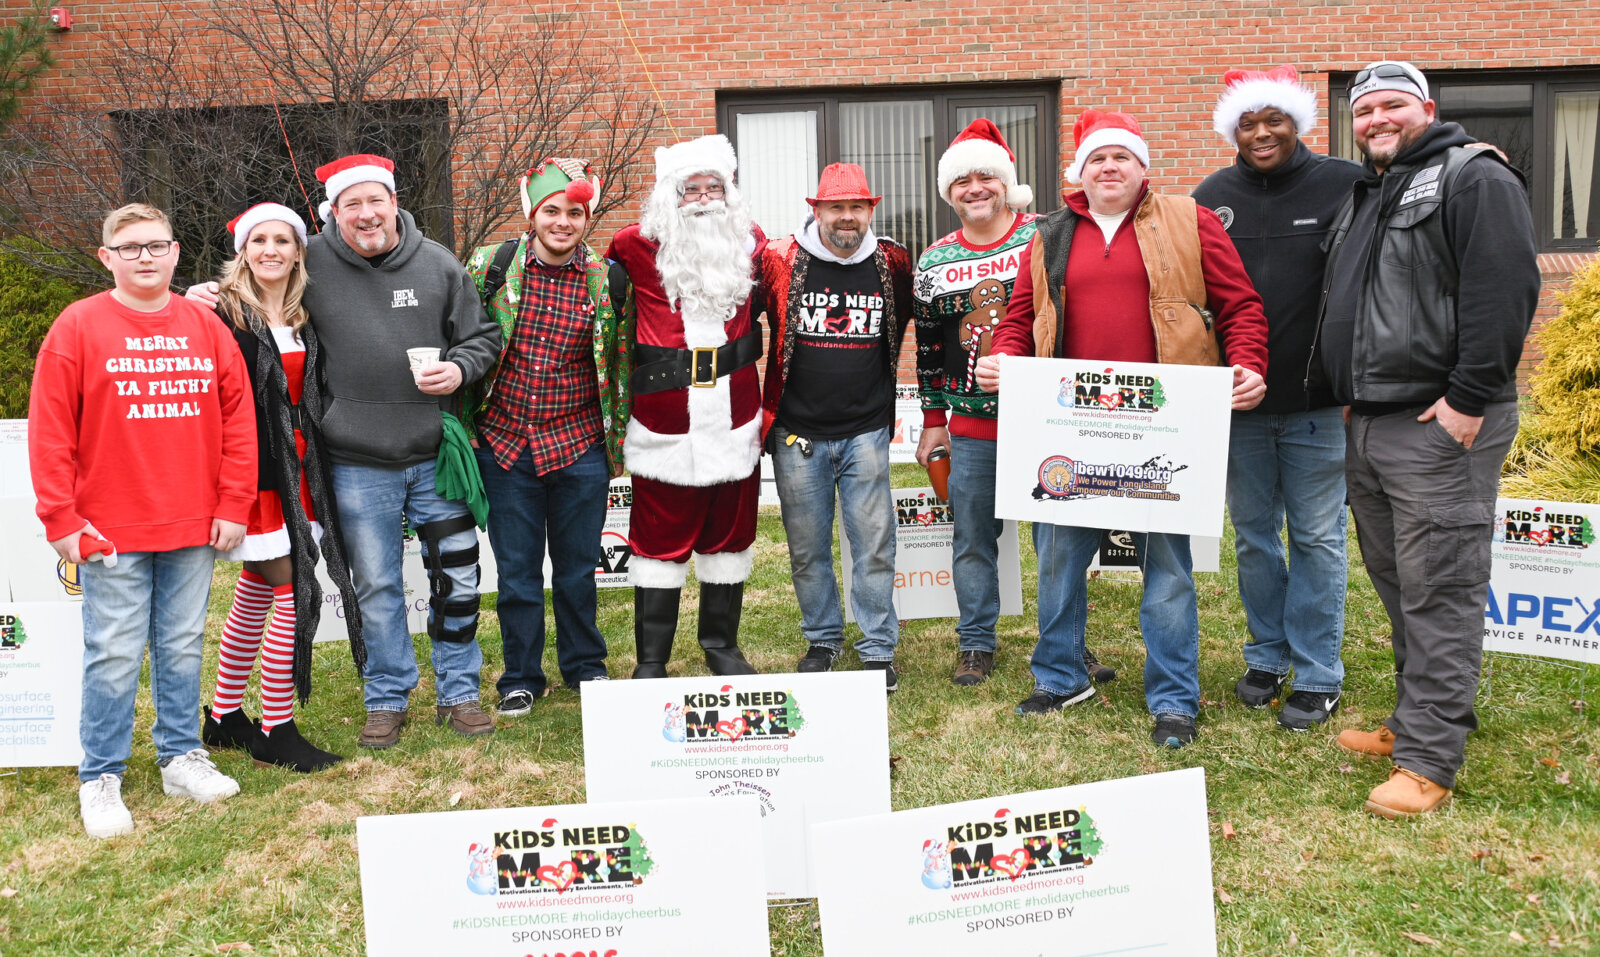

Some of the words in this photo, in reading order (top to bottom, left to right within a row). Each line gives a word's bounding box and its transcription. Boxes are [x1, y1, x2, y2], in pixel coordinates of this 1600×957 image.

[946, 266, 972, 283] OH
[977, 254, 1018, 278] SNA
[845, 294, 884, 310] NEED
[125, 335, 189, 352] MERRY
[105, 357, 214, 373] CHRISTMAS
[115, 380, 141, 396] YA
[149, 379, 212, 396] FILTHY
[1115, 374, 1155, 387] NEED
[126, 401, 201, 419] ANIMAL
[1072, 411, 1152, 422] www.kidsneedmore.org
[1078, 429, 1131, 440] SPONSORED
[1114, 422, 1179, 433] #holidaycheerbus
[1073, 461, 1173, 484] ibew1049.org
[1078, 477, 1090, 485] We
[1091, 477, 1116, 487] Power
[1119, 479, 1140, 490] Long
[1141, 481, 1167, 490] Island
[1072, 486, 1109, 496] Empower
[1126, 489, 1180, 501] Communities
[1545, 513, 1584, 526] NEED
[1107, 549, 1137, 557] 631-84
[1503, 545, 1582, 558] www.kidsneedmore.org
[1509, 562, 1560, 574] SPONSORED
[1563, 567, 1574, 575] BY
[596, 576, 628, 584] maceutical
[1484, 628, 1525, 641] RVICE
[735, 691, 788, 707] NEED
[684, 743, 789, 754] www.kidsneedmore.org
[741, 754, 824, 767] #holidaycheerbus
[695, 769, 764, 780] SPONSORED
[766, 767, 780, 778] BY
[709, 783, 731, 797] John
[732, 780, 771, 798] Theissen
[1014, 809, 1081, 833] NEED
[562, 825, 630, 846] NEED
[951, 874, 1084, 902] www.kidsneedmore.org
[954, 877, 995, 888] Motivational
[499, 888, 542, 896] Motivational
[1025, 884, 1130, 907] #holidaycheerbus
[496, 893, 634, 910] www.kidsneedmore.org
[572, 906, 681, 925] #holidaycheerbus
[967, 910, 1053, 933] SPONSORED
[1058, 907, 1075, 919] BY
[512, 927, 601, 943] SPONSORED
[606, 926, 624, 937] BY
